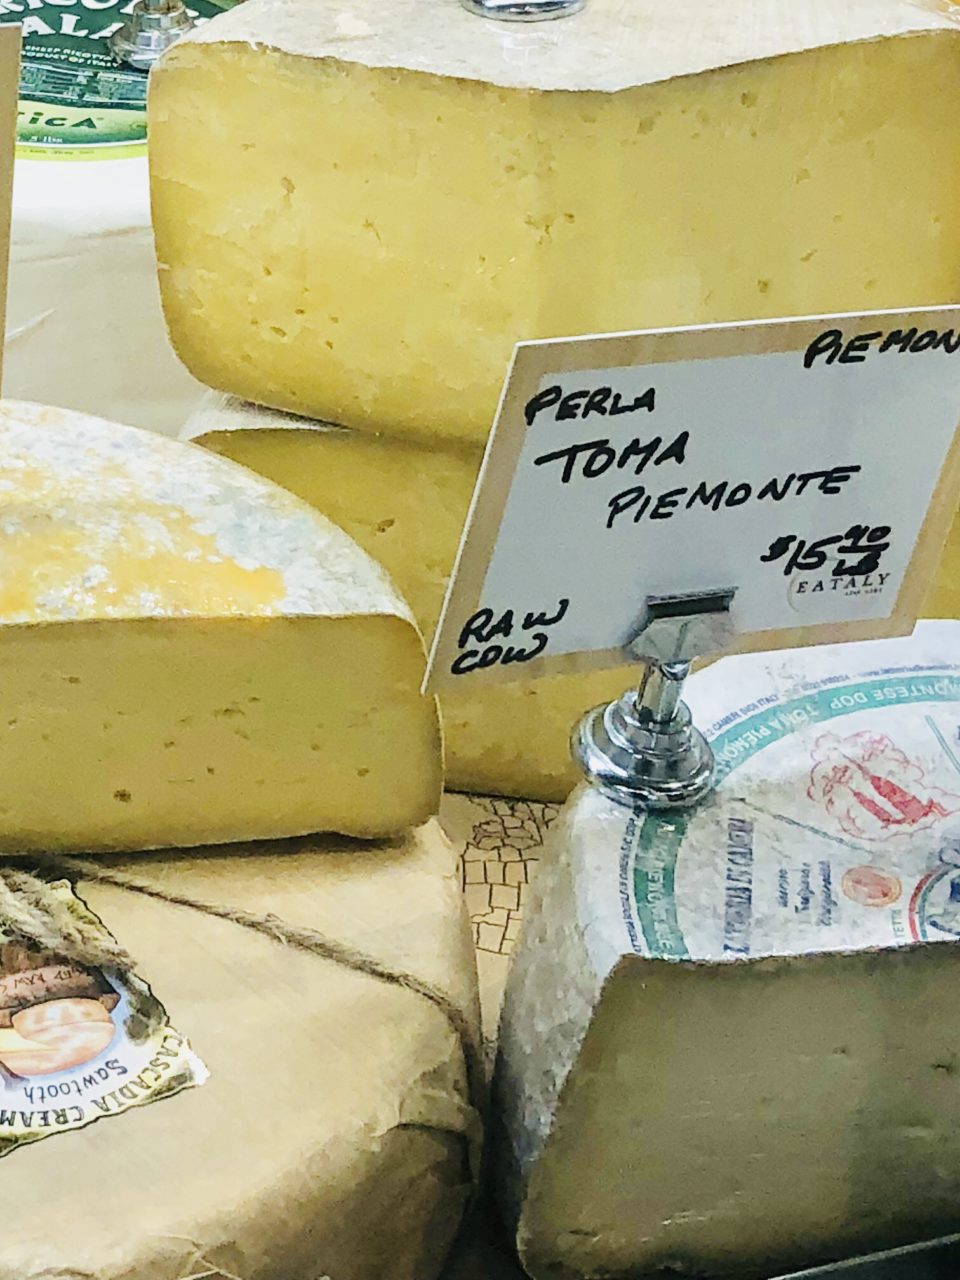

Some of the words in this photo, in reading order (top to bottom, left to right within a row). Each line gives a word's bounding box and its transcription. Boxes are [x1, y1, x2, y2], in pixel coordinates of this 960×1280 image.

[525, 386, 655, 426] PERLA
[534, 431, 690, 484] TOMA
[606, 465, 861, 529] PIEMONTE
[796, 573, 891, 595] EATALY
[457, 599, 570, 648] RAW
[451, 633, 548, 675] COW
[830, 691, 868, 711] DOP
[23, 1057, 128, 1104] Sawtooth
[95, 1031, 186, 1114] CASCADIA
